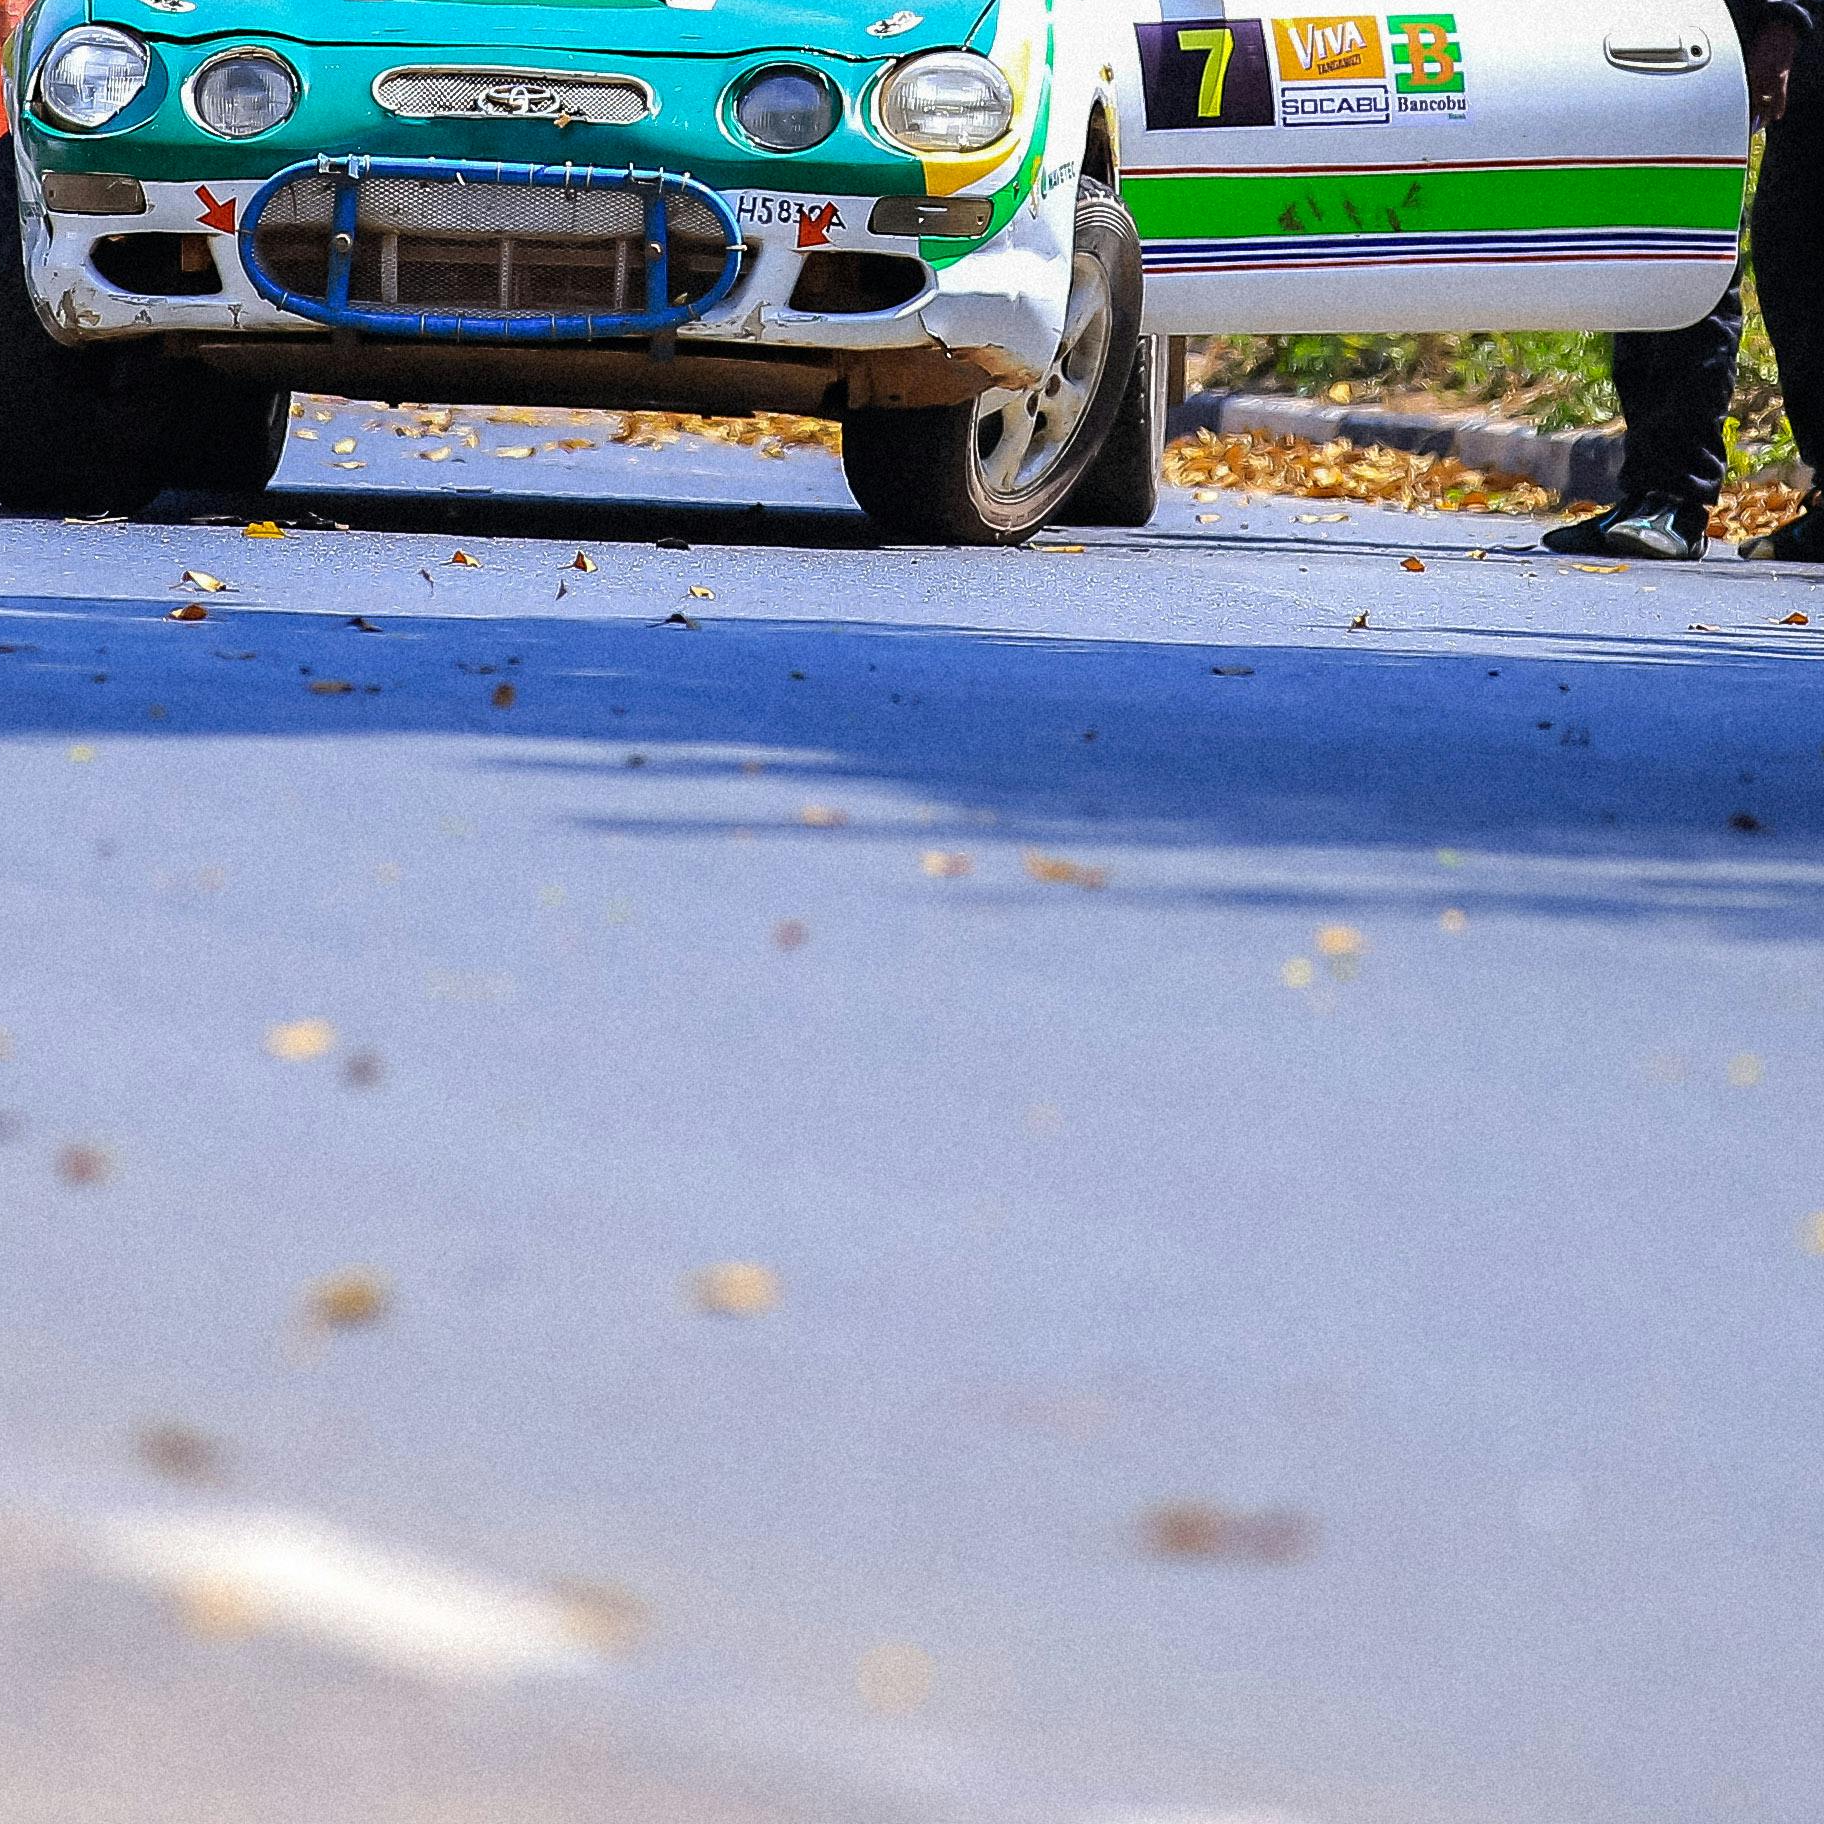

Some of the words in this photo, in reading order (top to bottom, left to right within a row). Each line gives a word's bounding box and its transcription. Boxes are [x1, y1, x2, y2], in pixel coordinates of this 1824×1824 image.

[1288, 21, 1367, 71] VIVA
[1400, 22, 1455, 87] B
[1178, 27, 1234, 118] 7
[1281, 96, 1390, 116] SOCABU
[1397, 95, 1467, 113] Bancobu
